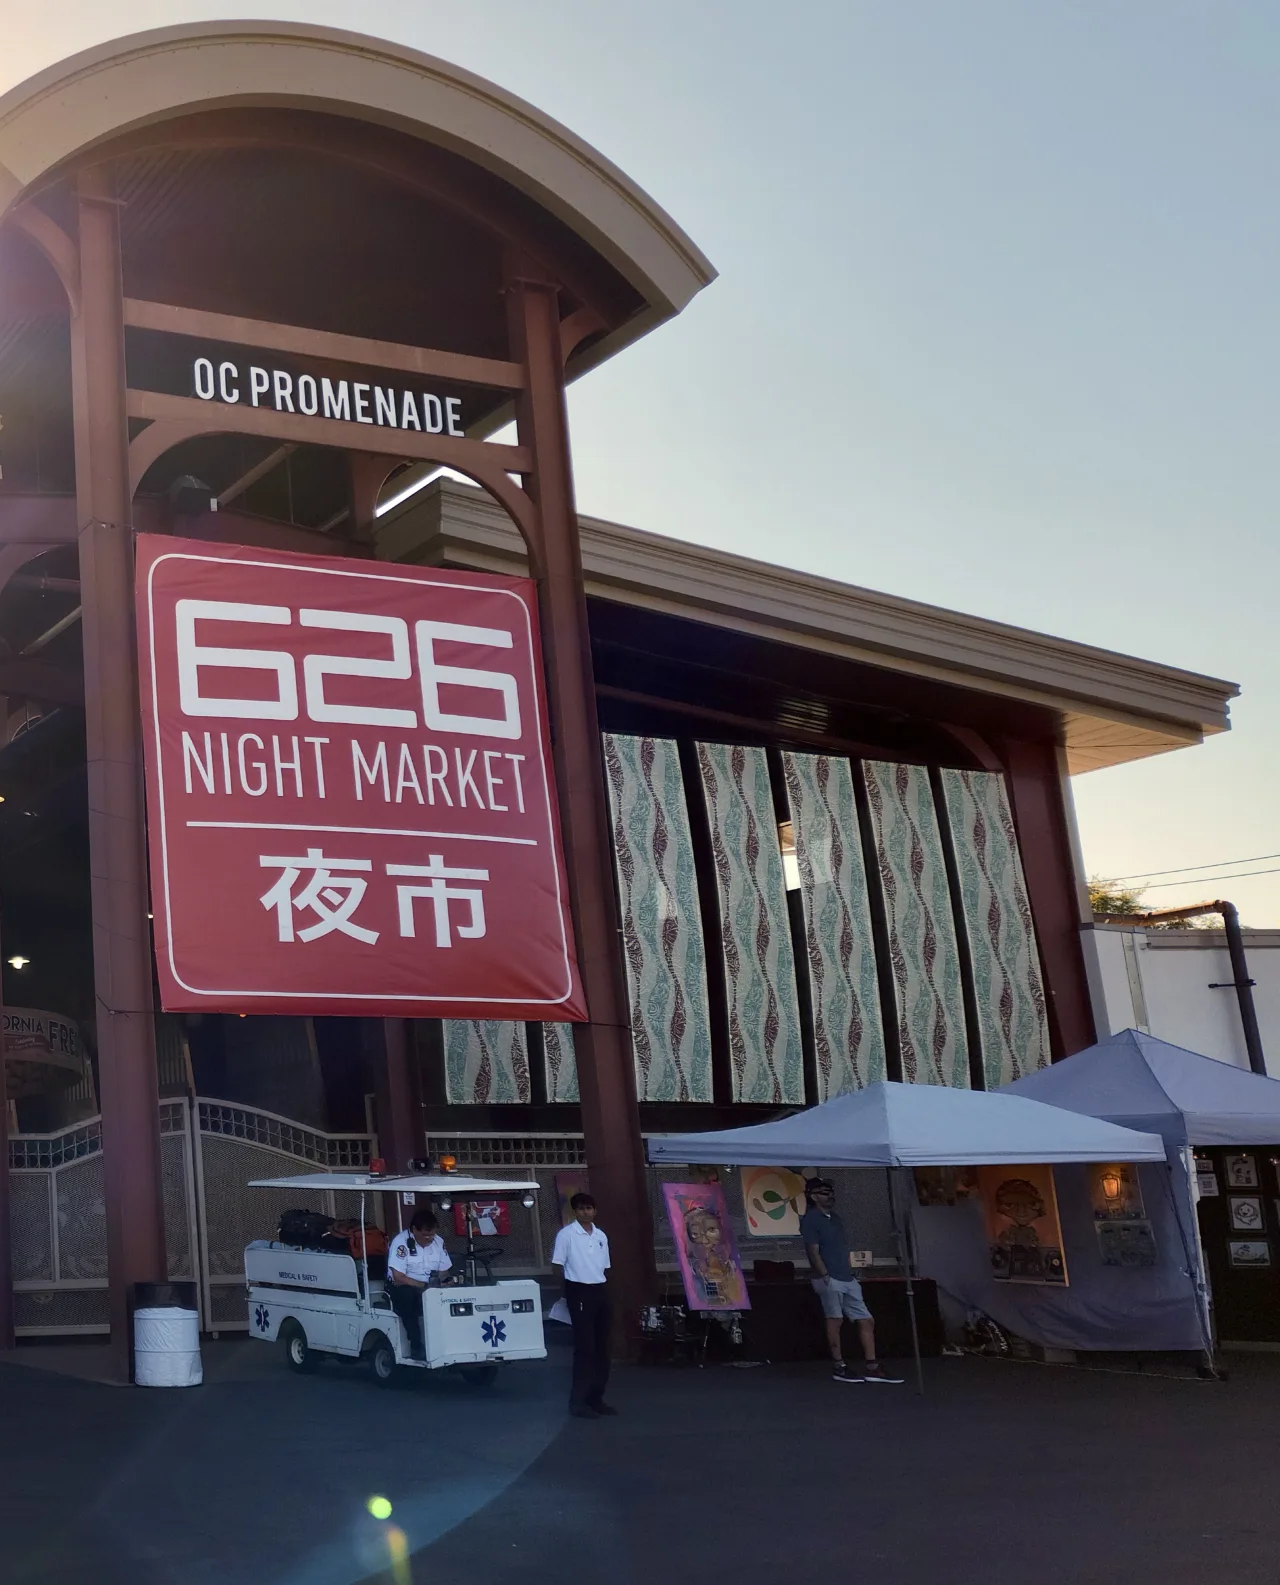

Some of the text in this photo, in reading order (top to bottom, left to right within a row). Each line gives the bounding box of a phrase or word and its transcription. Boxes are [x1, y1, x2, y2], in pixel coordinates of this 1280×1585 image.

[193, 357, 466, 438] OC PROMENADE
[175, 599, 523, 740] 626
[180, 730, 527, 815] NIGHT MARKET
[258, 847, 491, 949] 夜市
[278, 1271, 297, 1280] MEDICAL
[301, 1273, 318, 1282] SAFETY
